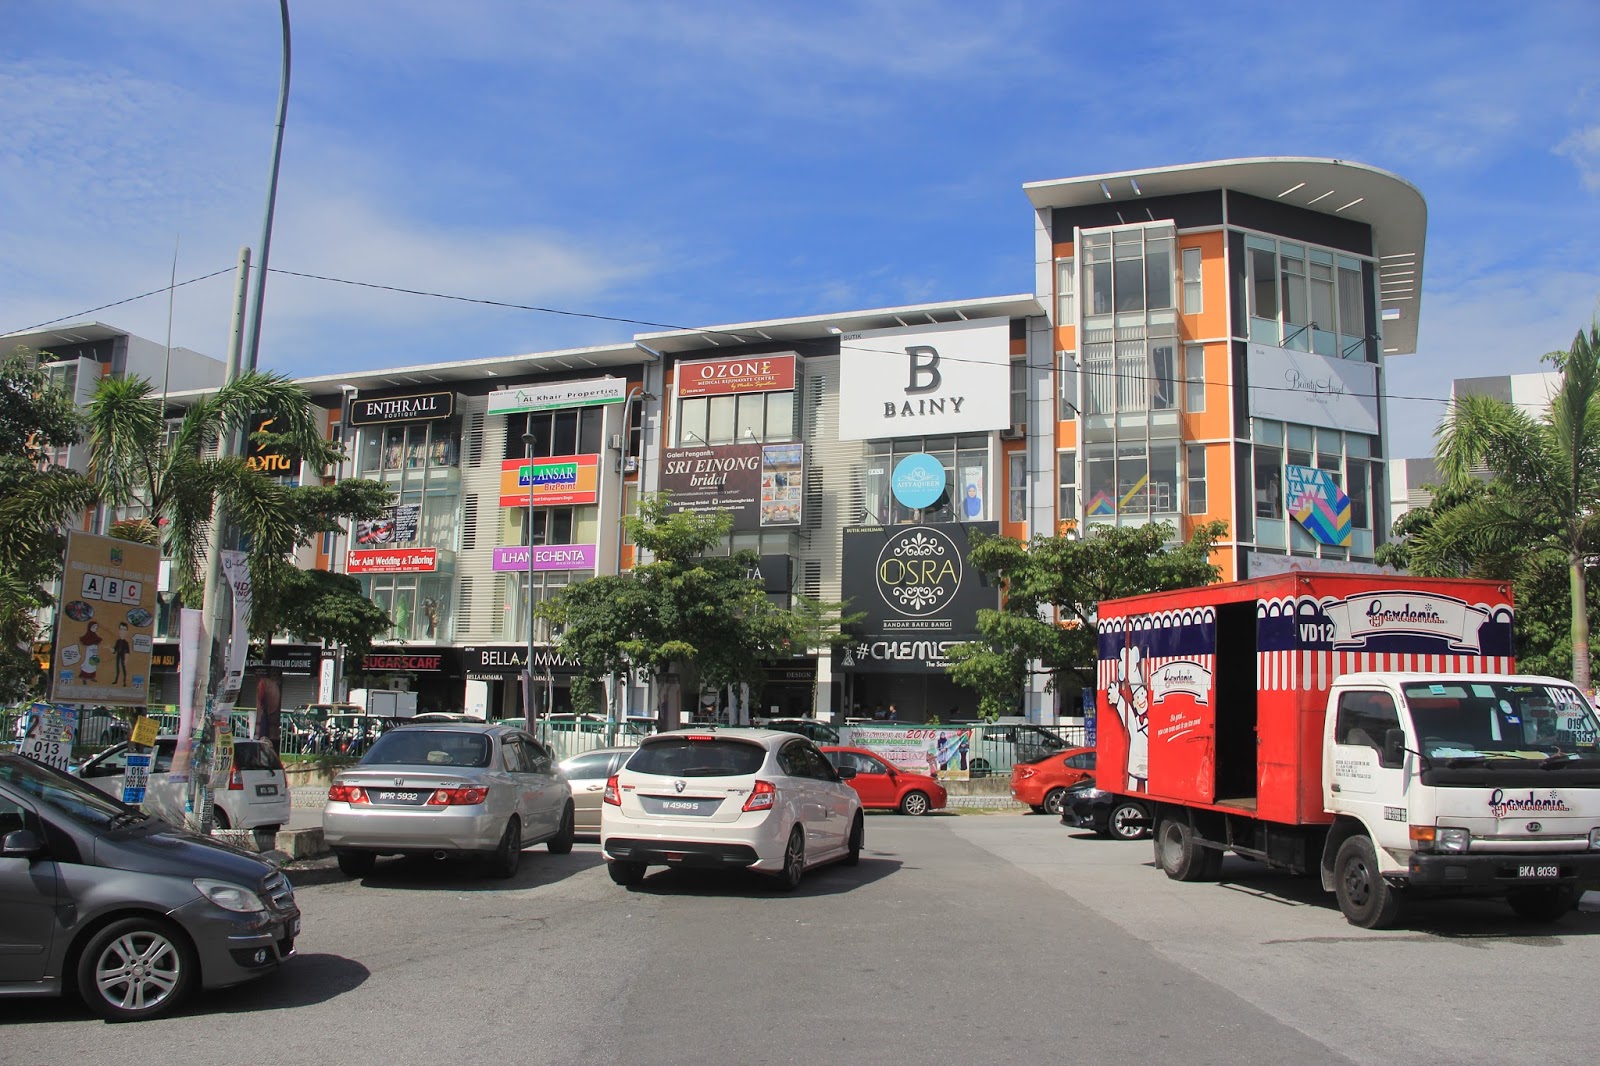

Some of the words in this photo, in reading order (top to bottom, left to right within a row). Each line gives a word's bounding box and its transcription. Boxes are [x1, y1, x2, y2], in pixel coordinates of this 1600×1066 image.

[701, 361, 771, 379] OZONE
[904, 345, 942, 395] B
[1285, 369, 1317, 398] Beauty
[567, 388, 619, 398] Properties
[366, 397, 437, 416] ENTHRALL
[883, 396, 965, 418] BAINY
[384, 410, 418, 419] BOUTIQUE
[665, 460, 693, 474] SRI
[694, 456, 760, 473] EINONG
[538, 466, 574, 480] ANSAR
[690, 473, 727, 486] bridal
[544, 483, 576, 491] BizPoint
[349, 558, 360, 566] Nor
[362, 557, 374, 566] Aini
[376, 556, 400, 567] Wedding
[408, 555, 433, 566] Tailoring
[535, 550, 585, 562] ECHENTA
[880, 558, 958, 586] OSRA
[88, 578, 97, 591] A
[109, 581, 117, 594] B
[128, 584, 136, 597] C
[1366, 599, 1445, 627] Gardenia
[1300, 623, 1334, 642] VD12
[291, 660, 311, 668] CUISINE
[362, 656, 441, 669] SUGARSCARF
[481, 650, 520, 666] BELLA
[1543, 686, 1581, 705] VD12
[906, 729, 937, 739] 2016
[34, 741, 59, 754] 013
[131, 766, 144, 775] 016
[380, 791, 395, 800] WPR
[397, 792, 418, 800] 5932
[670, 801, 692, 809] 4949
[692, 802, 699, 810] S
[1488, 788, 1570, 817] Gardenia
[1519, 866, 1535, 877] BKA
[1537, 866, 1557, 877] 8039
